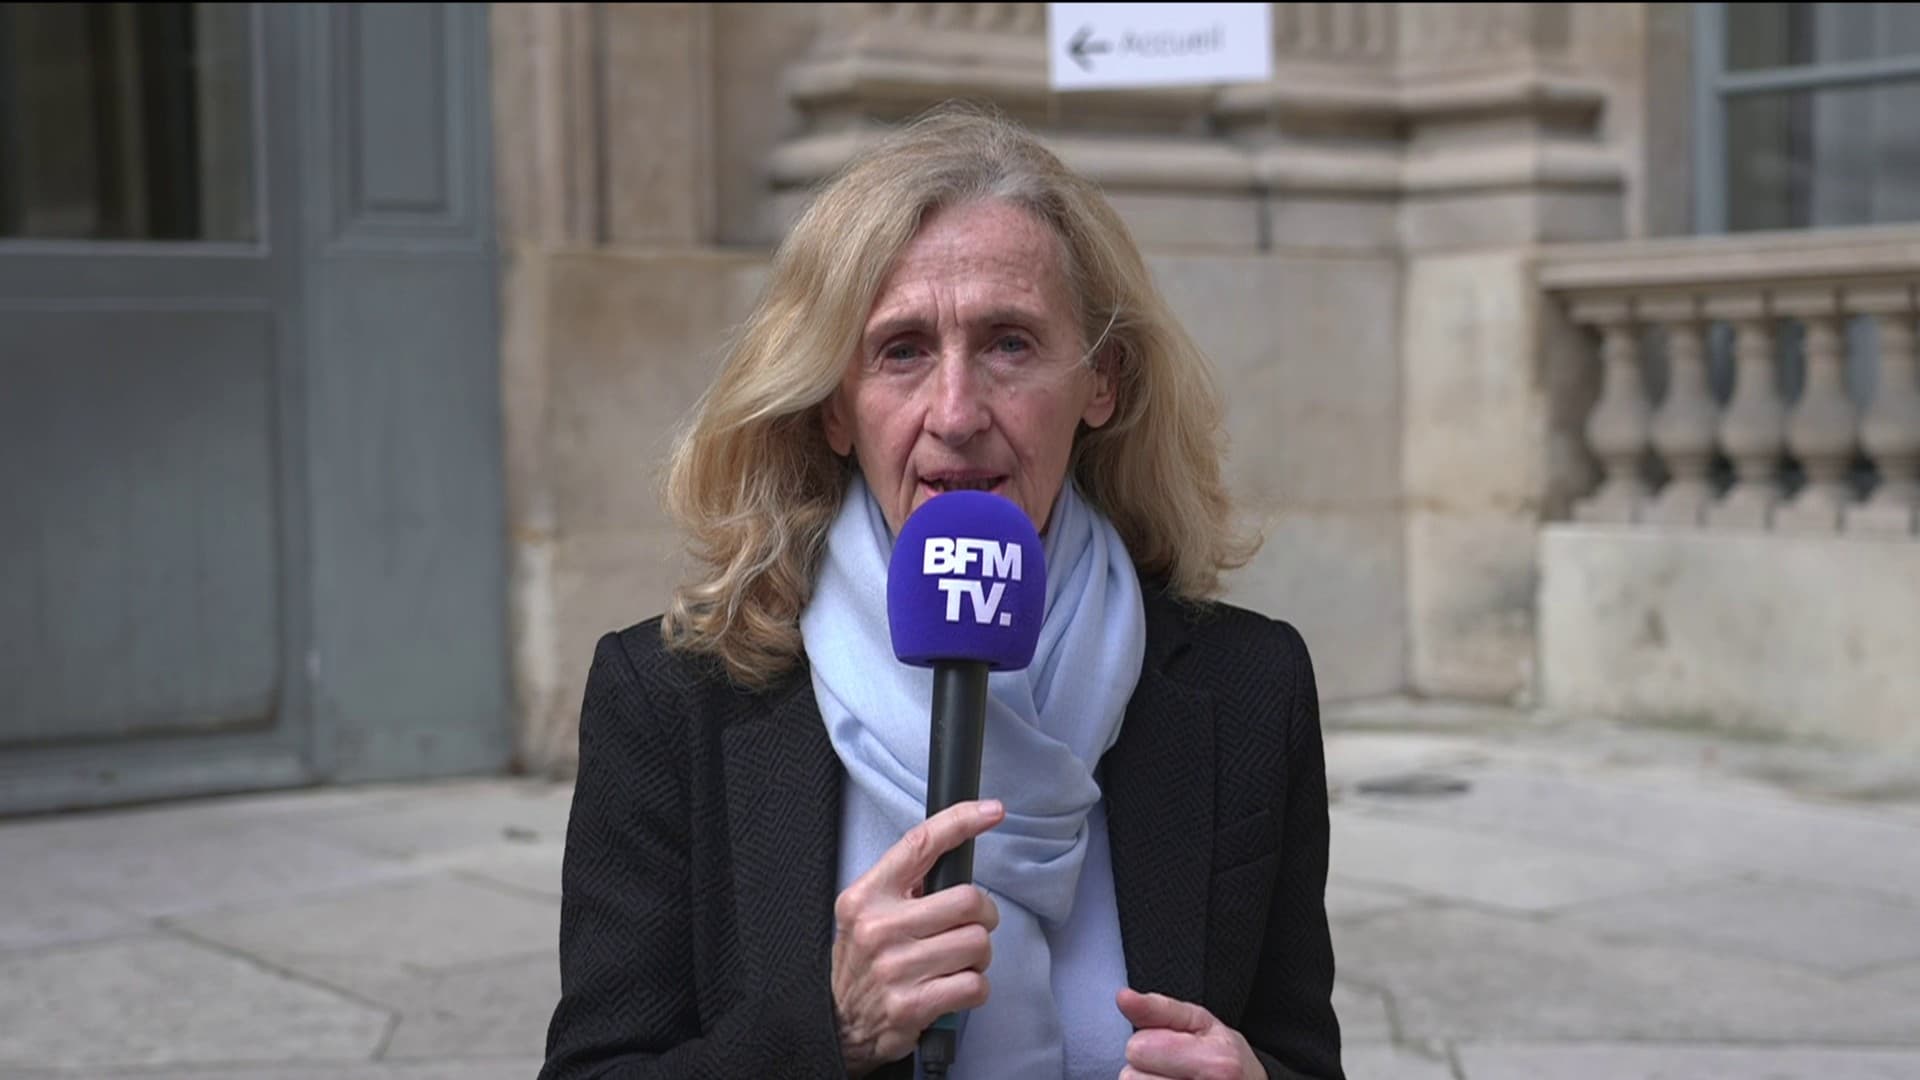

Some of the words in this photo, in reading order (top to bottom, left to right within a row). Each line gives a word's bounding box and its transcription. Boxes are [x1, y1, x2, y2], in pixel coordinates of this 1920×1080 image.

[1119, 23, 1226, 57] Accueil
[923, 537, 1022, 581] BFM
[938, 578, 1012, 626] TV.
